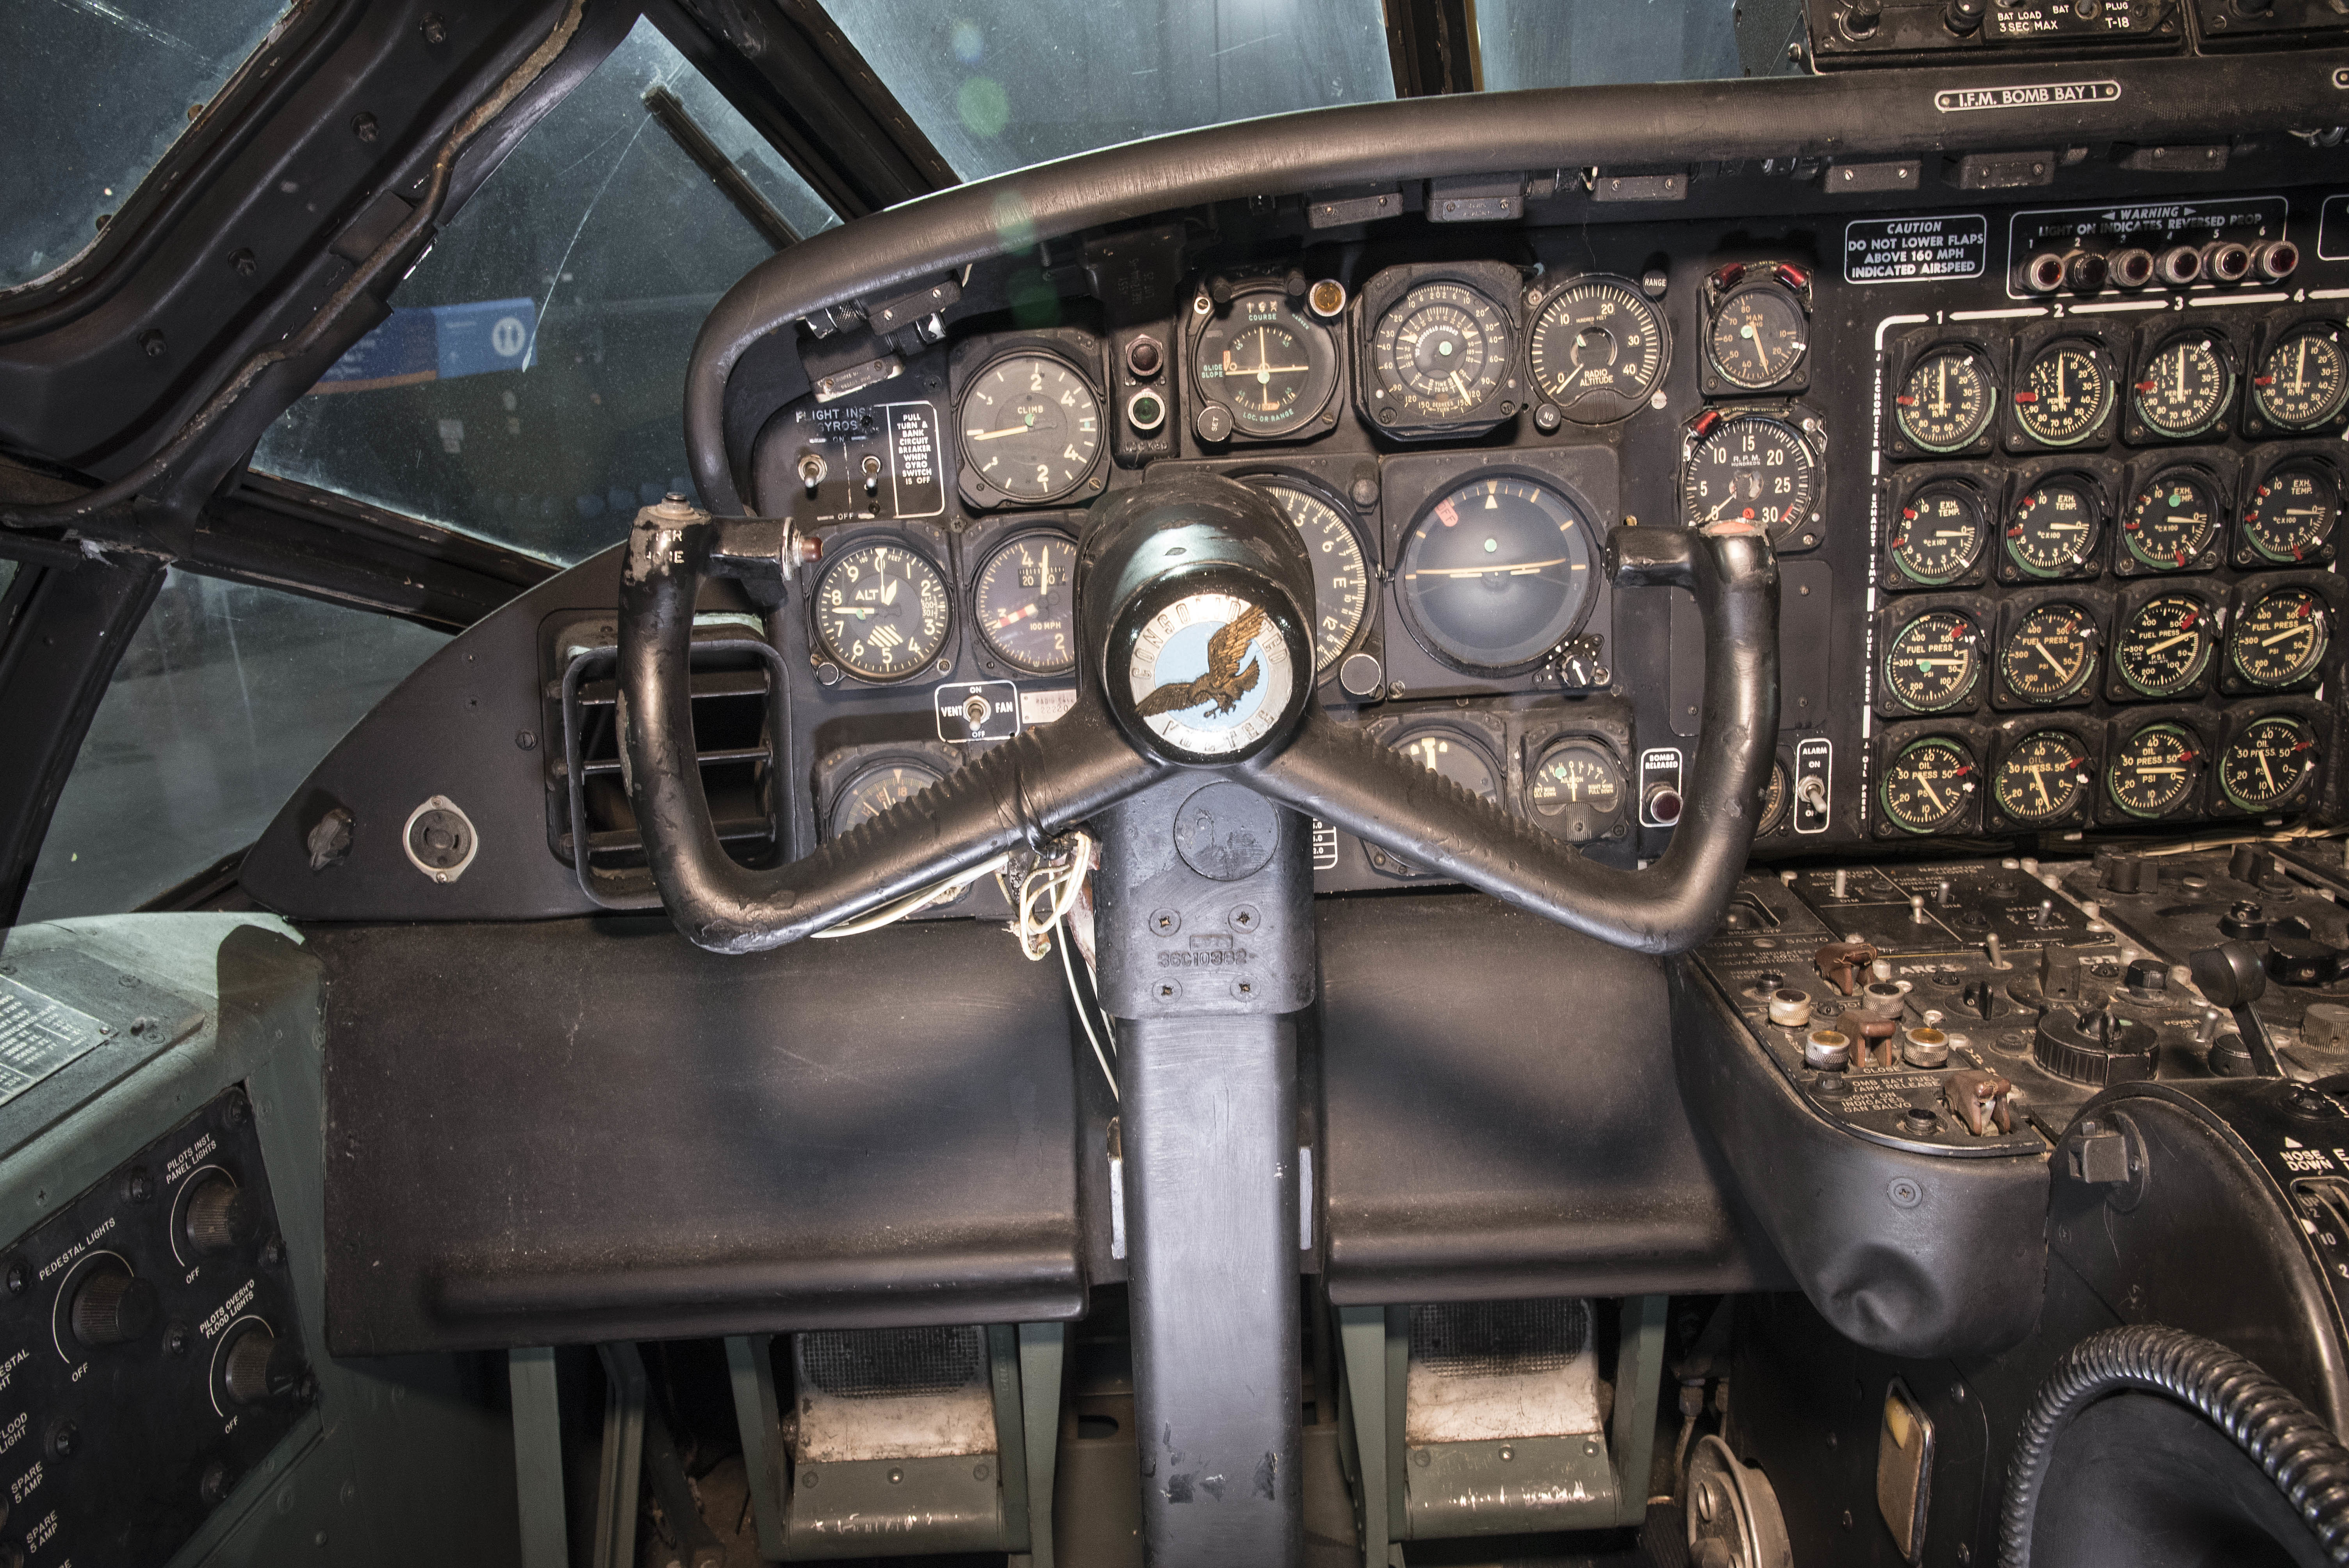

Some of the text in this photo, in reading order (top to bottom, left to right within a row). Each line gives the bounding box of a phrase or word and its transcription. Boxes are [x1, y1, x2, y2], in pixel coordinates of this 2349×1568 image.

[2053, 5, 2069, 14] BAT
[2105, 2, 2128, 10] PLUG
[1998, 11, 2042, 21] BAT LOAD
[2000, 20, 2058, 32] 3 SEC MAX
[2105, 17, 2130, 28] T-18
[1959, 85, 2097, 107] I.F.M. BOMB BAY 1
[2121, 207, 2179, 219] WARNING
[1887, 222, 1942, 234] CAUTION
[2039, 214, 2262, 237] LIGHT ON INDICATES REVERSED PROP
[1848, 233, 1984, 251] DO NOT LOWER FLAPS
[2075, 238, 2081, 247] 2
[2121, 235, 2126, 243] 3
[2167, 232, 2173, 240] 4
[2214, 229, 2219, 238] 5
[2259, 226, 2265, 236] 6
[1864, 248, 1964, 264] ABOVE 160 MPH
[1852, 261, 1975, 278] INDICATED AIRSPEED
[1645, 278, 1666, 287] RANGE
[1601, 303, 1614, 315] 20
[1936, 289, 2304, 324] 1 2 3 4
[1291, 314, 1309, 330] MARKER
[1560, 314, 1569, 325] 10
[1628, 336, 1639, 346] 30
[1584, 369, 1607, 378] RADIO
[1623, 364, 1636, 374] 40
[1031, 374, 1041, 390] 2
[1580, 376, 1613, 387] ALTITUDE
[1243, 412, 1257, 421] LOC.
[1271, 409, 1294, 421] RANGE
[1211, 416, 1219, 431] SET
[900, 437, 928, 445] CIRCUIT
[1743, 436, 1755, 451] 15
[898, 445, 931, 454] BREAKER
[1714, 448, 1726, 463] 10
[1767, 449, 1783, 465] 20
[902, 469, 932, 477] SWITCH
[847, 566, 859, 582] 9
[1023, 576, 1034, 586] 20
[1334, 577, 1347, 588] E
[921, 579, 931, 597] 2
[855, 590, 879, 600] ALT
[1928, 644, 1953, 652] PRESS
[941, 705, 962, 717] VENT
[995, 702, 1013, 713] FAN
[1803, 747, 1827, 755] ALARM
[1919, 761, 1932, 770] OIL
[2137, 756, 2162, 765] PRESS
[1886, 1082, 1941, 1090] RELEASE
[1842, 1098, 1905, 1107] INDICATES
[1873, 1102, 1912, 1111] SALVO
[167, 1133, 210, 1172] PILOTS INST
[2280, 1149, 2325, 1161] NOSE
[166, 1140, 216, 1184] PANEL LIGHTS
[2287, 1159, 2334, 1171] DOWN
[39, 1217, 115, 1281] PEDESTAL LIGHTS
[186, 1266, 199, 1284] OFF
[200, 1279, 255, 1334] PILOTS OVERH'D
[206, 1290, 254, 1339] FLOOD LIGHTS
[72, 1362, 88, 1382] OFF
[225, 1416, 239, 1435] OFF
[0, 1425, 26, 1454] LIGHT
[11, 1461, 43, 1494] SPARE
[14, 1474, 43, 1504] 5 AMP
[26, 1509, 57, 1544] SPARE
[30, 1523, 57, 1553] 5 AMP
